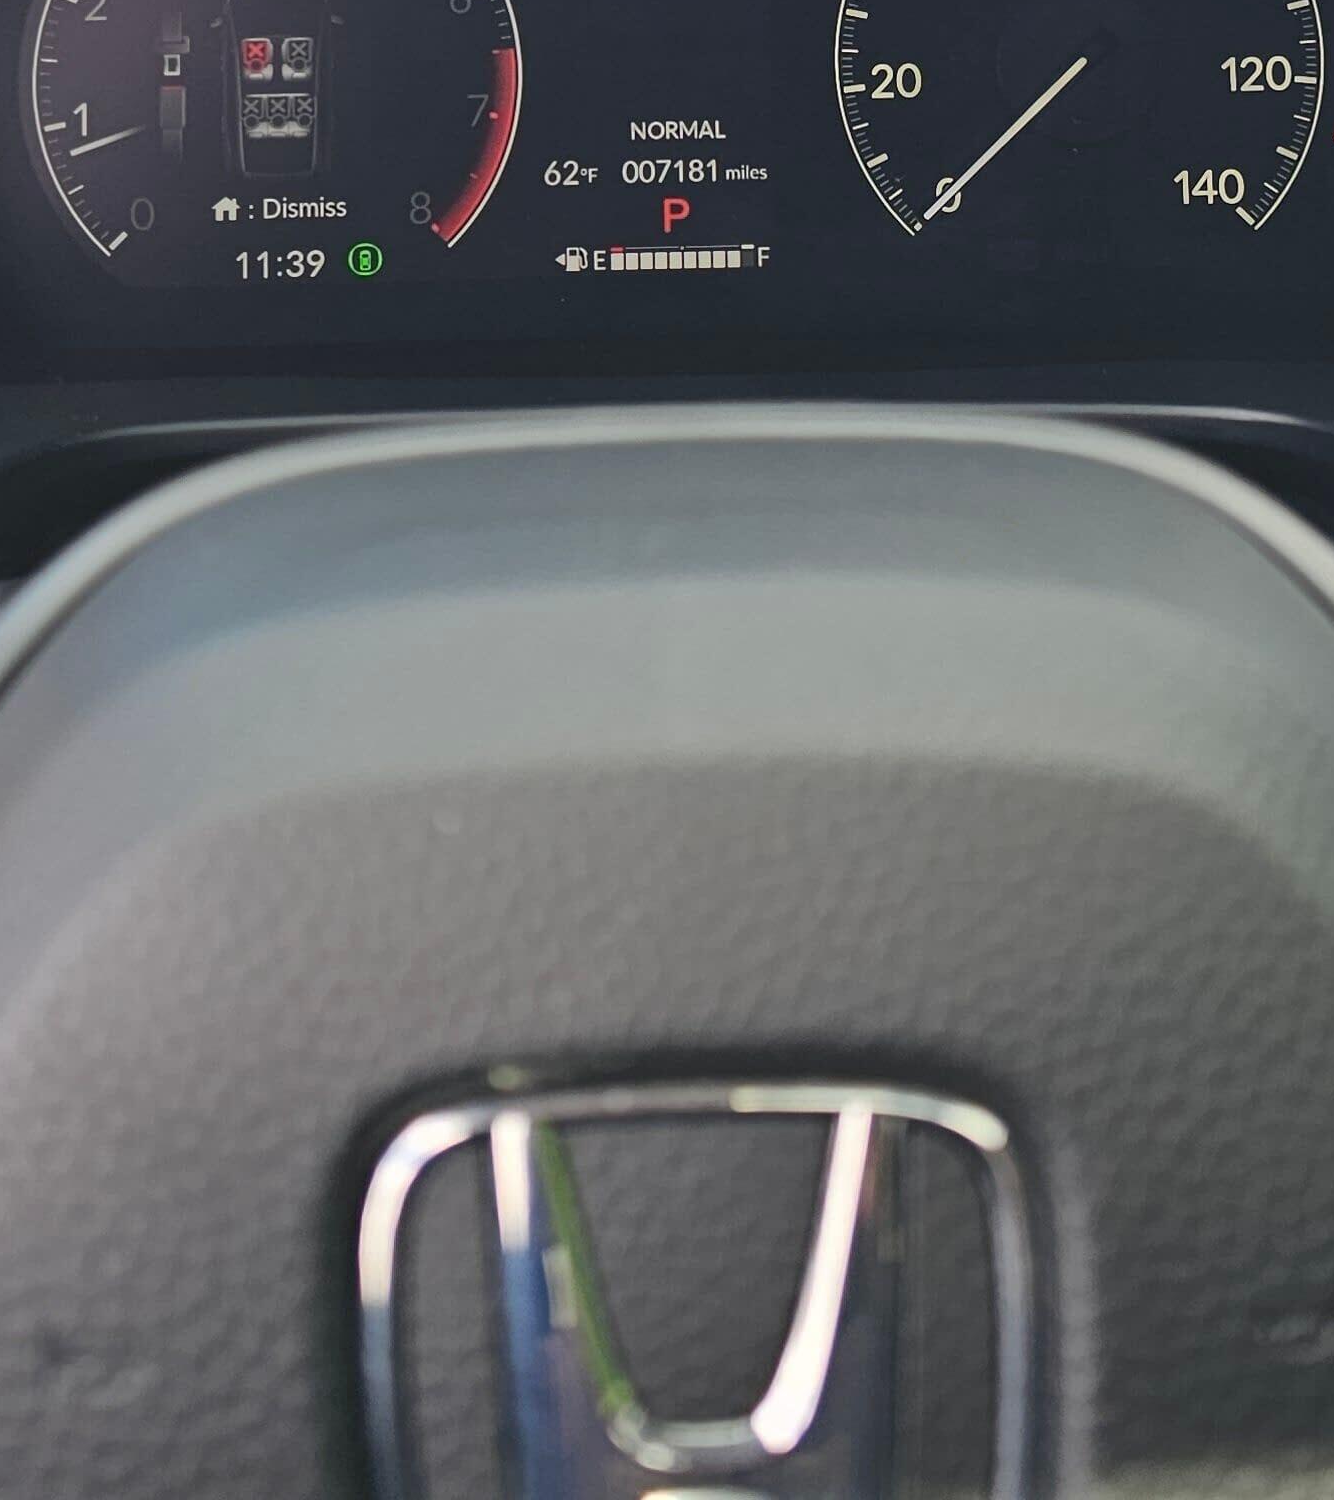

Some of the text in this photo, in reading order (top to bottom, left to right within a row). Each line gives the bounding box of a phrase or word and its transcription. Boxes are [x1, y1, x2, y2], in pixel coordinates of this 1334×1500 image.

[870, 63, 923, 100] 20
[1221, 55, 1292, 92] 120
[72, 102, 90, 135] 1
[466, 94, 489, 127] 7
[630, 120, 726, 141] NORMAL
[621, 158, 768, 184] 007181 miles
[1173, 168, 1244, 205] 140
[130, 198, 155, 231] 0
[262, 197, 347, 220] Dismiss
[409, 191, 433, 225] 8
[662, 197, 691, 234] P
[235, 250, 326, 280] 11:39
[594, 246, 771, 271] E F
